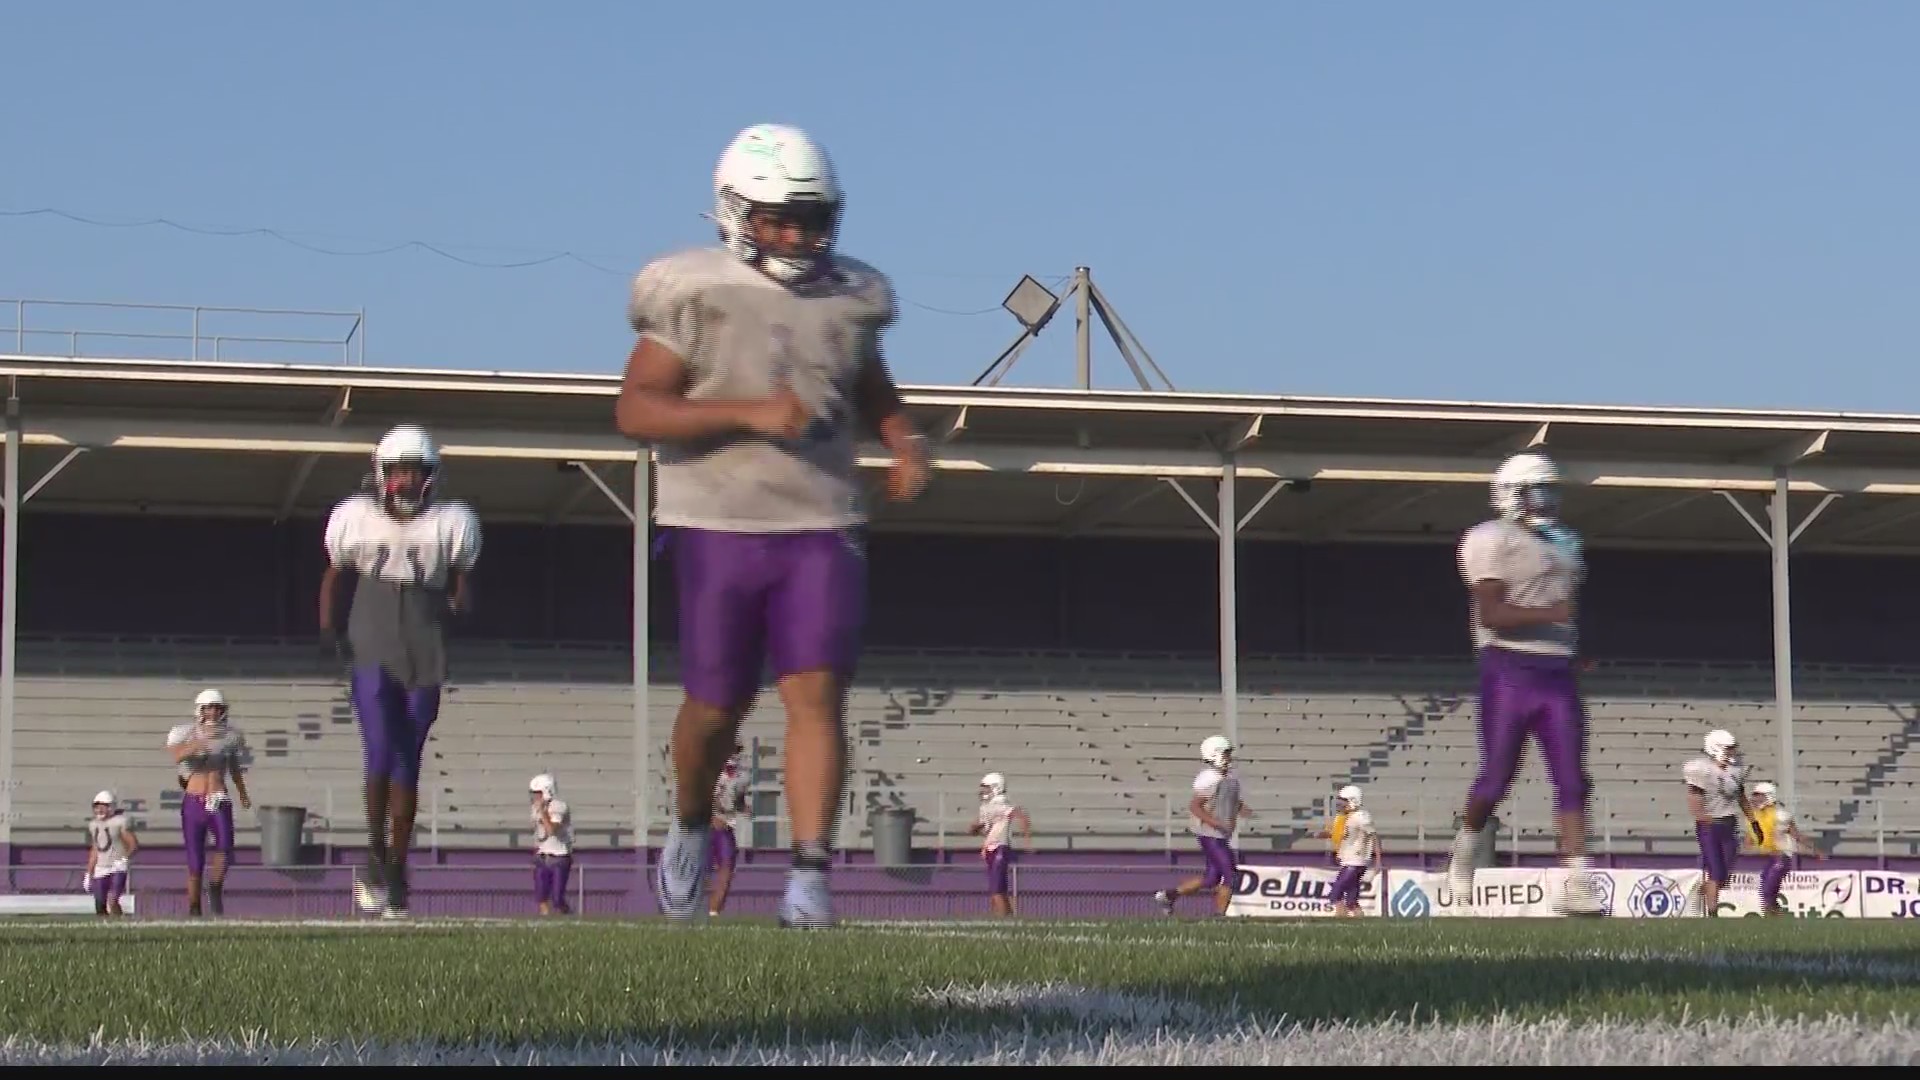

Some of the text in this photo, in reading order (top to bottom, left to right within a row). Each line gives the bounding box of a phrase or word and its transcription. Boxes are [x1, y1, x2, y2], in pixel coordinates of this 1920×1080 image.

[1232, 869, 1376, 899] Delue
[1866, 876, 1910, 894] DR.
[1270, 901, 1335, 912] DOORS
